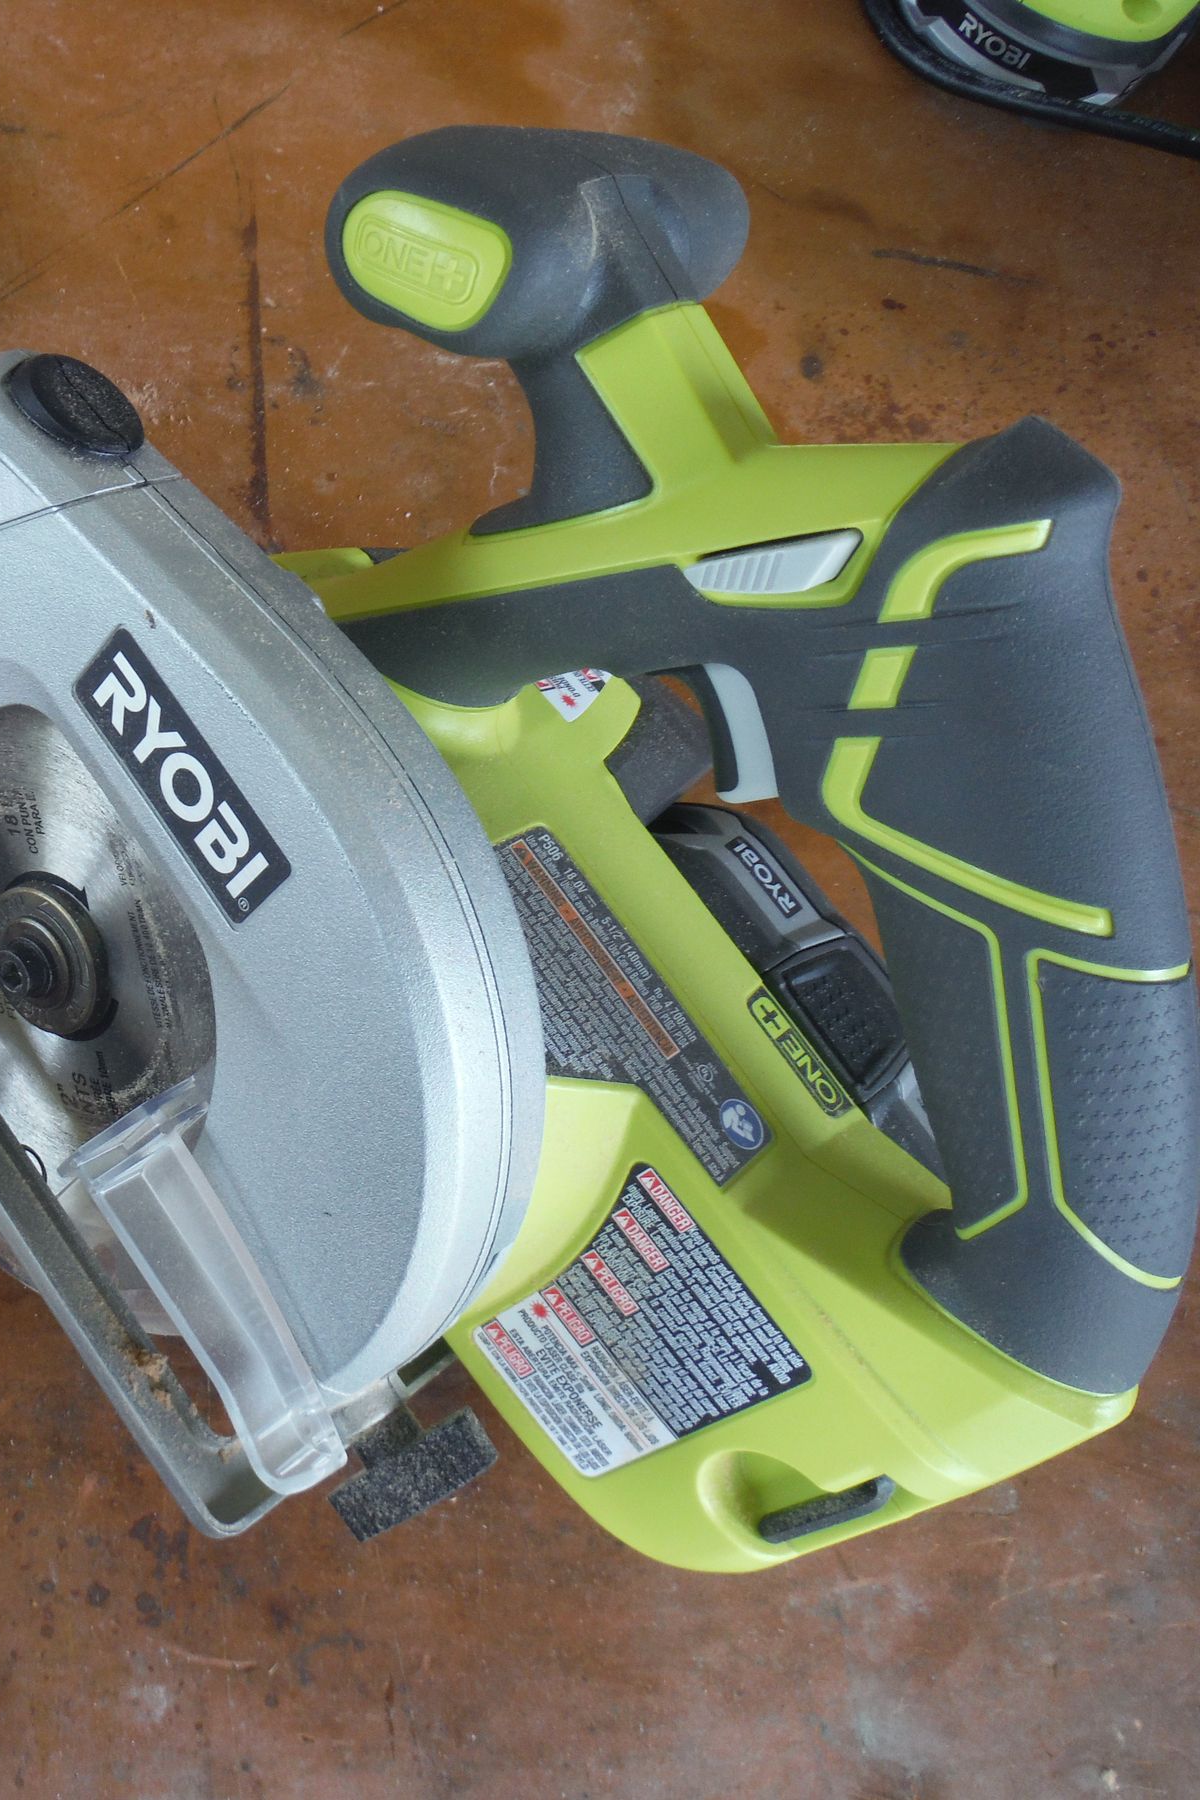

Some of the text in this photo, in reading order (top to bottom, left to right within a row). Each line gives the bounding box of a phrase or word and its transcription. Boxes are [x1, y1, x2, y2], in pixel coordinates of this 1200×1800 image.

[958, 12, 1031, 69] RYOBI
[92, 651, 269, 898] RYOBI
[537, 833, 563, 861] P506
[541, 857, 562, 878] Battery
[733, 839, 797, 914] RYOBI
[618, 941, 652, 980] (140mm)
[584, 976, 604, 997] battery
[663, 1068, 679, 1084] Hold
[672, 1081, 688, 1096] saw
[649, 1185, 691, 1228] DANGER
[624, 1224, 665, 1267] DANGER
[648, 1230, 670, 1249] Laser
[662, 1248, 692, 1277] radiation
[684, 1276, 697, 1284] is
[594, 1268, 635, 1310] PELIGRO
[641, 1204, 663, 1223] Laser
[655, 1221, 685, 1250] radiation
[677, 1249, 698, 1267] when
[704, 1283, 726, 1302] avoid
[718, 1301, 740, 1321] direct
[732, 1319, 750, 1332] eye
[741, 1331, 773, 1362] exposure.
[766, 1362, 790, 1384] AVOID
[686, 1226, 805, 1368] Keep hands and body away from and to the side
[689, 1283, 716, 1309] emitted
[516, 1309, 547, 1343] PRODUCTO
[553, 1302, 590, 1339] PELIGRO
[708, 1307, 728, 1324] from
[495, 1336, 530, 1373] PELIGRO
[539, 1324, 568, 1355] POTENCIA
[729, 1334, 759, 1364] aperture.
[534, 1348, 560, 1374] EVITE
[555, 1375, 603, 1429] EXPONERSE
